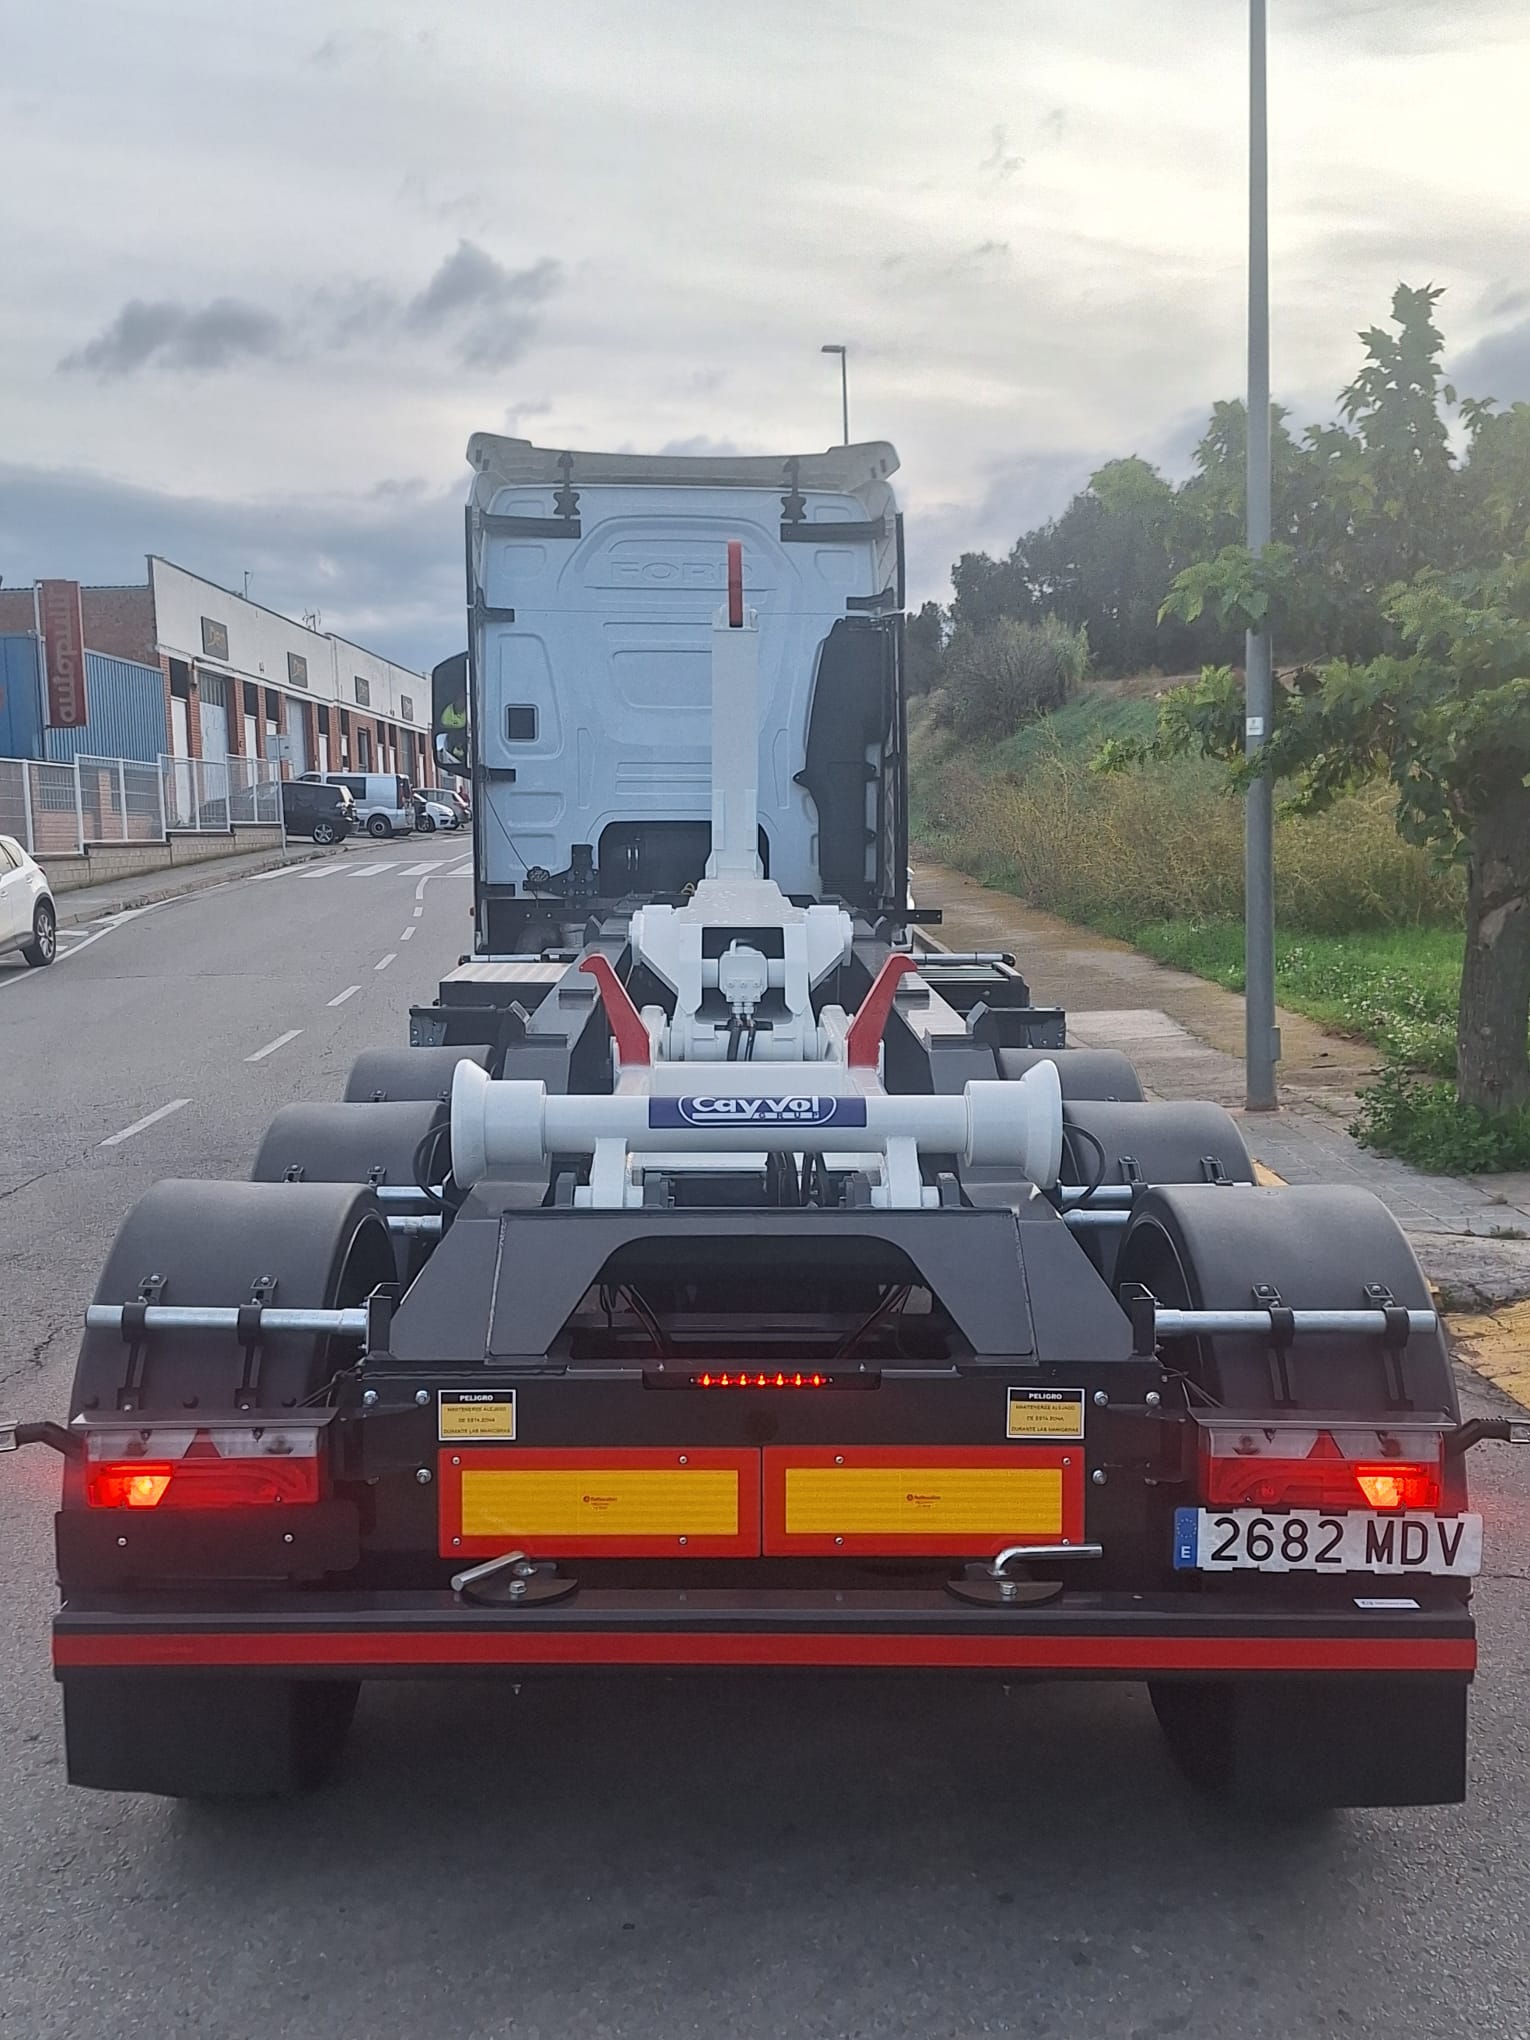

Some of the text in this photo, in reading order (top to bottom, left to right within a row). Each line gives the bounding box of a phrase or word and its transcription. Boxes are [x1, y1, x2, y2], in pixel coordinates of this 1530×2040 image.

[1180, 1545, 1192, 1560] E
[1210, 1517, 1466, 1567] 2682 MDV
